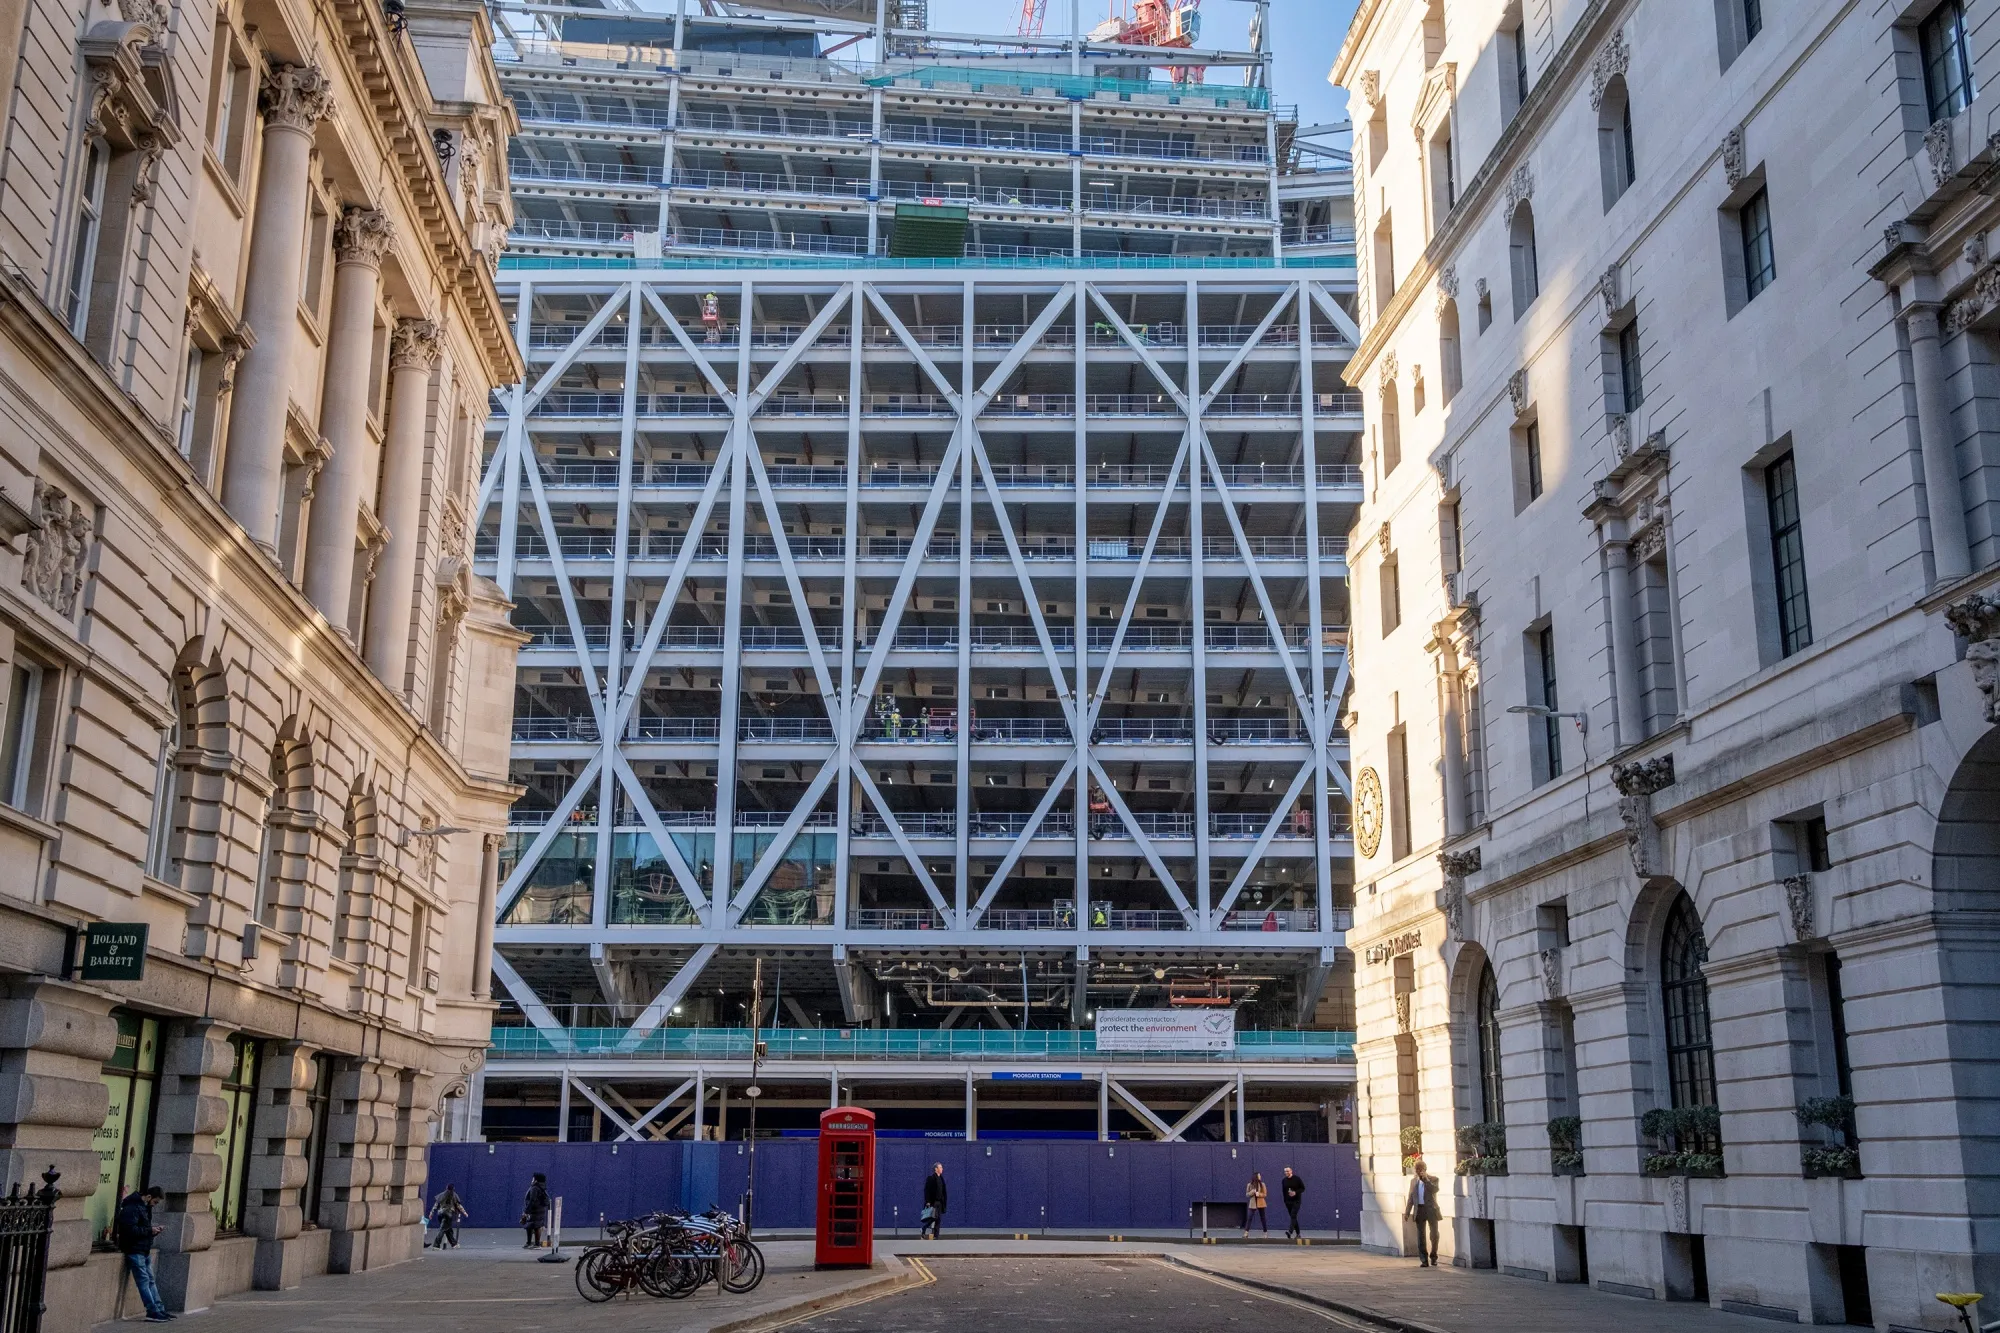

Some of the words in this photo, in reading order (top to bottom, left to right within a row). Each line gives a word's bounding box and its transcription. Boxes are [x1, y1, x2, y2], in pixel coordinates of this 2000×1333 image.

[92, 934, 137, 946] HOLLAND
[1394, 929, 1422, 955] NatWest
[109, 944, 119, 956] &
[89, 956, 134, 967] BARRETT
[1099, 1015, 1136, 1023] Considerate
[1136, 1015, 1176, 1023] constructors
[1100, 1024, 1129, 1034] protect
[1130, 1024, 1145, 1032] the
[1145, 1024, 1197, 1032] environment
[108, 1102, 120, 1117] and
[93, 1126, 113, 1141] piness
[113, 1124, 119, 1139] is
